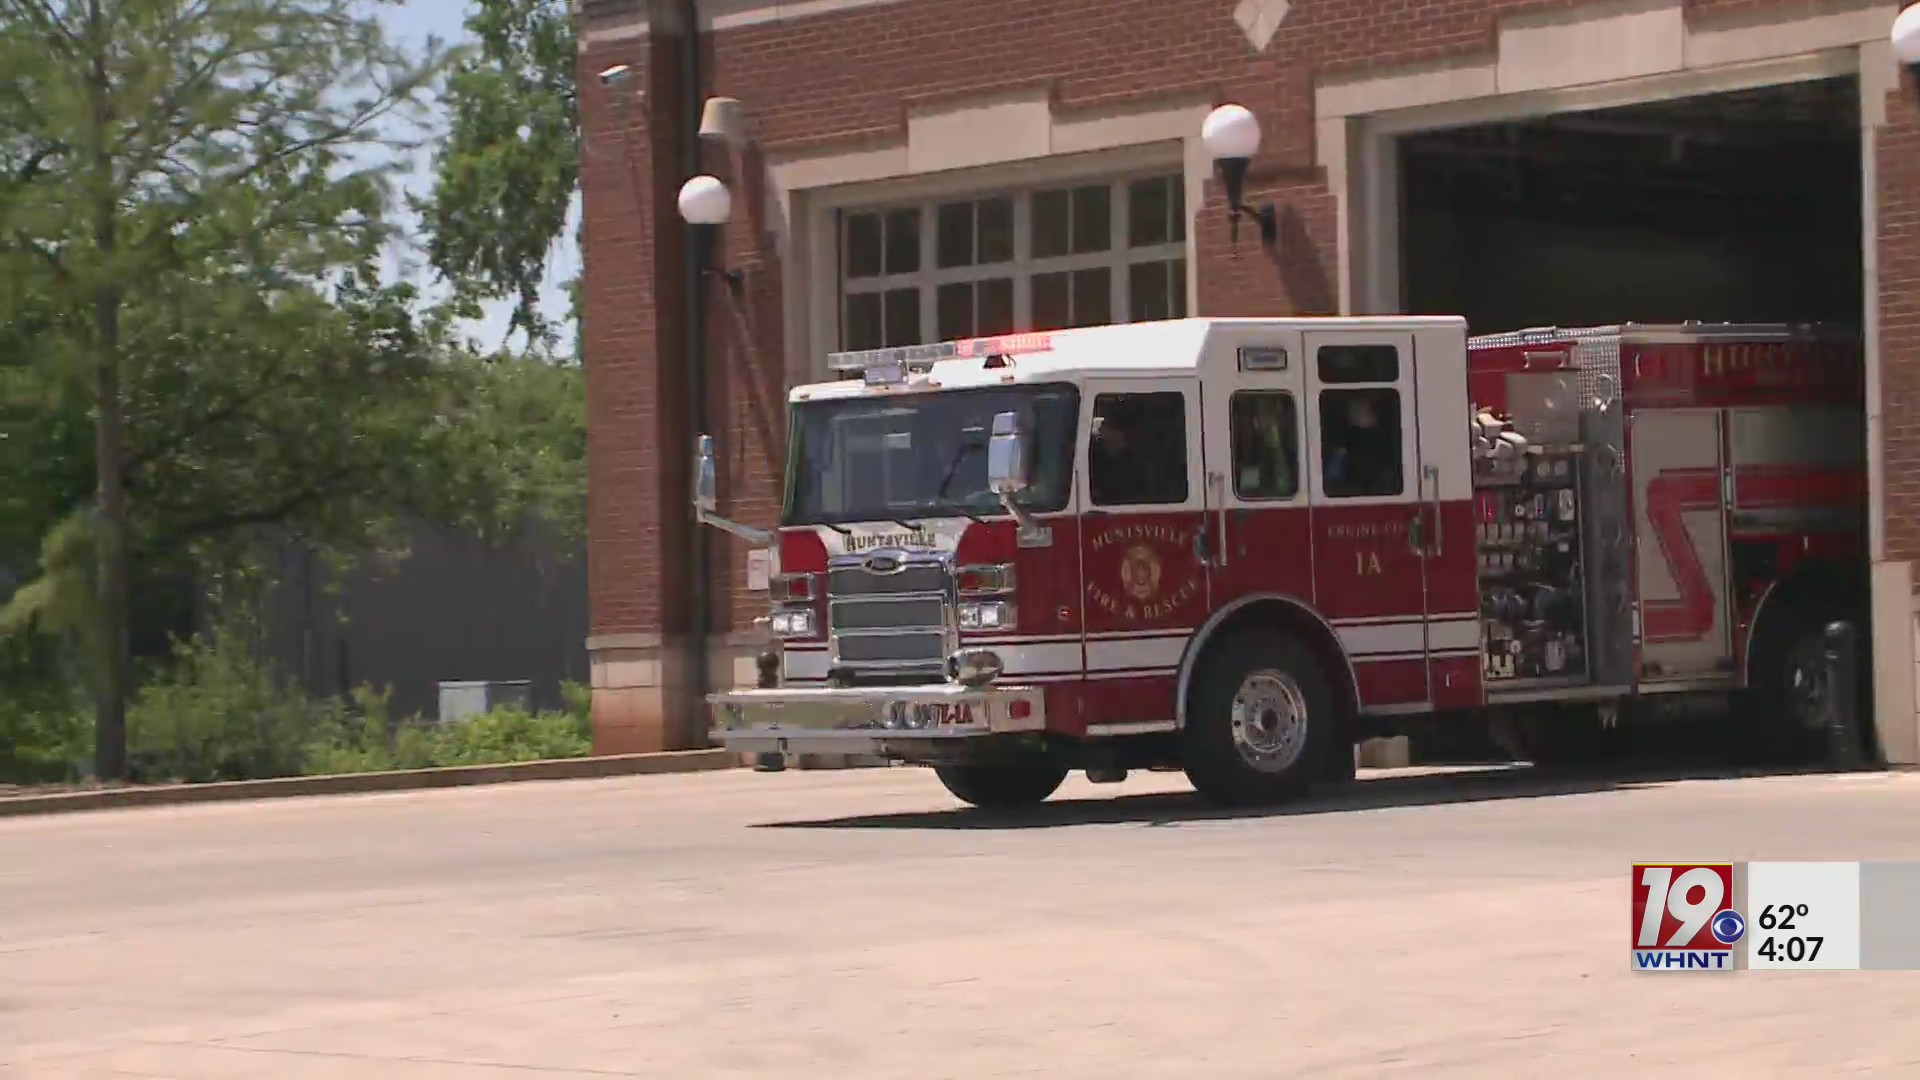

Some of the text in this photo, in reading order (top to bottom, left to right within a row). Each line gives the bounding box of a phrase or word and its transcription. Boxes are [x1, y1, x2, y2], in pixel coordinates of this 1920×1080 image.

[843, 531, 936, 552] HUNTSVILLE
[1092, 524, 1186, 550] HUNTSVILLE
[1355, 550, 1382, 576] 1A
[1087, 580, 1117, 613] FIRE
[1143, 578, 1196, 618] RESCUE
